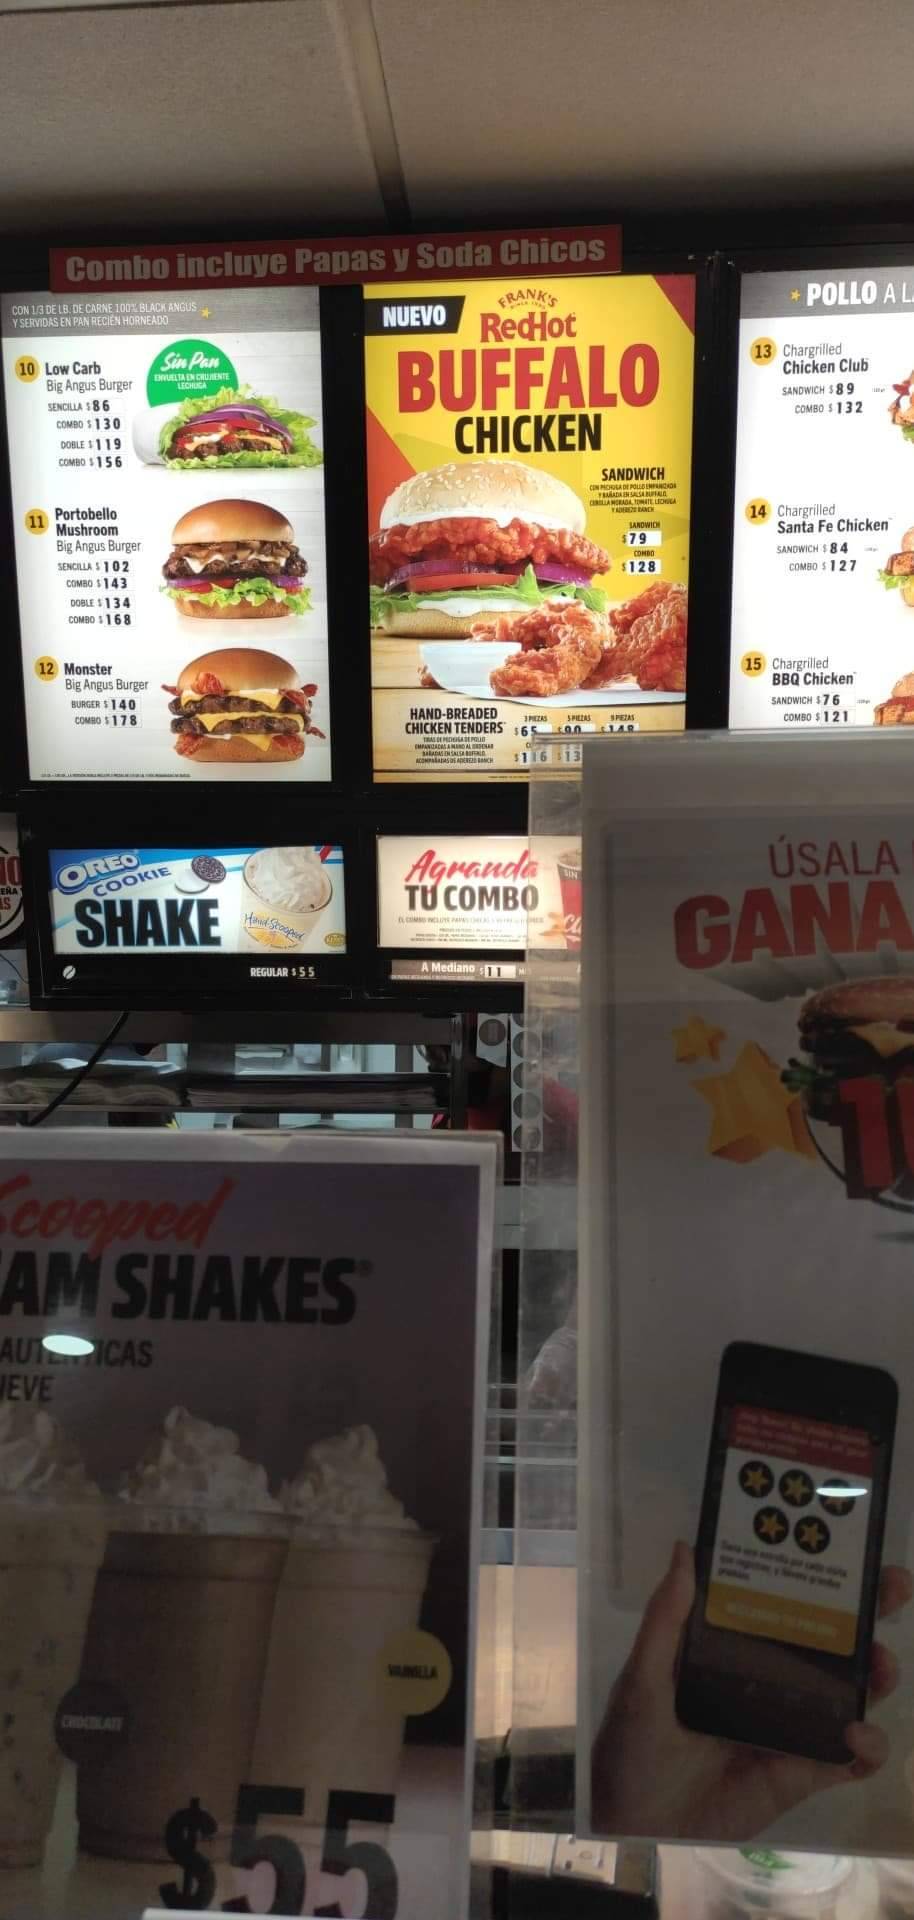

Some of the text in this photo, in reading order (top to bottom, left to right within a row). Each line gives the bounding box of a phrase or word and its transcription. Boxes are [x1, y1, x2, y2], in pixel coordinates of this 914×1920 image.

[66, 237, 606, 282] Combo incluye Papas y Soda Chicos
[498, 288, 559, 309] FRANK'S
[806, 280, 896, 306] POLLO A
[12, 301, 197, 316] CON 1/3 DE LB. DE CARNE 100% BLACK ANGUS
[383, 305, 447, 327] NUEVO
[13, 314, 168, 329] Y SERVIDAS EN PAN RECIÉN HORNEADO
[480, 311, 577, 343] RedHot
[755, 344, 772, 359] 13
[783, 342, 842, 358] Chargrilled
[19, 362, 35, 376] 10
[45, 361, 101, 376] Low Carb
[160, 351, 219, 372] Sin Pan
[783, 358, 869, 375] Chicken Club
[47, 377, 133, 394] Big Angus Burger
[398, 343, 660, 413] BUFFALO
[782, 386, 825, 396] SANDWICH
[47, 402, 83, 412] SENCILLA
[795, 404, 824, 414] COMBO
[56, 419, 84, 430] COMBO
[454, 412, 602, 455] CHICKEN
[60, 440, 85, 450] DOBLE
[58, 457, 86, 468] COMBO
[601, 467, 665, 481] SANDWICH
[55, 507, 118, 522] Portobello
[750, 504, 766, 519] 14
[777, 503, 836, 519] Chargrilled
[29, 515, 44, 529] 11
[629, 521, 661, 529] SANDWICH
[777, 518, 889, 534] Santa Fe Chicken
[56, 523, 119, 537] Mushroom
[56, 539, 141, 554] Big Angus Burger
[633, 550, 655, 558] COMBO
[777, 545, 819, 554] SANDWICH
[57, 562, 93, 572] SENCILLA
[789, 562, 818, 572] COMBO
[66, 579, 93, 588] COMBO
[70, 598, 94, 608] DOBLE
[68, 615, 95, 625] COMBO
[38, 662, 55, 676] 12
[64, 662, 113, 676] Monster
[745, 657, 762, 671] 15
[772, 656, 829, 671] Chargrilled
[65, 678, 149, 693] Big Angus Burger
[772, 671, 855, 687] BBQ Chicken
[71, 699, 101, 710] BURGER
[771, 696, 813, 706] SANDWICH
[75, 716, 102, 726] COMBO
[410, 707, 498, 720] HAND-BREADED
[528, 714, 548, 722] PIEZAS
[571, 714, 591, 722] PIEZAS
[615, 713, 635, 721] PIEZAS
[783, 712, 812, 722] COMBO
[405, 720, 504, 735] CHICKEN TENDERS
[769, 834, 899, 878] ÚSALA
[58, 853, 139, 892] OREO
[404, 849, 538, 885] Agranda
[92, 867, 172, 897] COOKIE
[404, 884, 539, 912] TU COMBO
[75, 899, 222, 948] SHAKE
[250, 966, 288, 978] REGULAR
[421, 963, 429, 972] A
[431, 961, 476, 973] Mediano
[0, 1250, 99, 1318] AM
[0, 1335, 153, 1368] AUTICAS
[61, 1715, 125, 1732] CHOCOLATE
